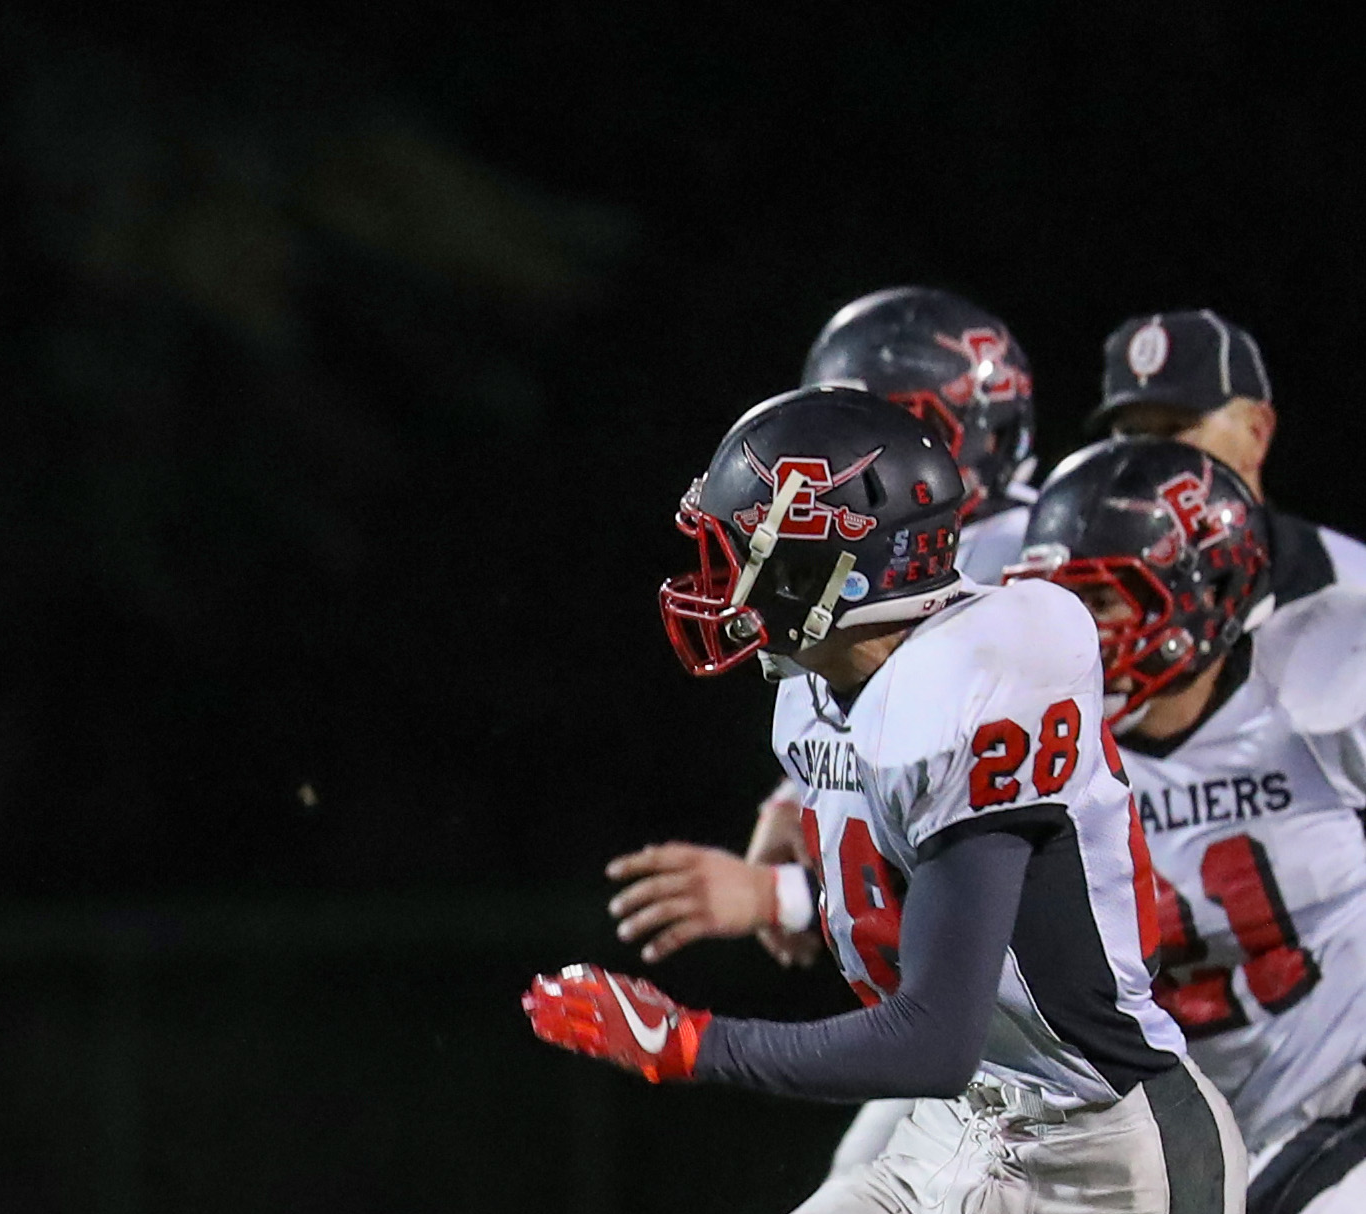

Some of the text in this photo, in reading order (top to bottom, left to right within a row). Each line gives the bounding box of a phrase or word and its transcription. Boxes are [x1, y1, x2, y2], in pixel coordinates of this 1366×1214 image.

[772, 457, 833, 540] E
[969, 700, 1081, 812] 28
[1140, 771, 1291, 834] ALIERS
